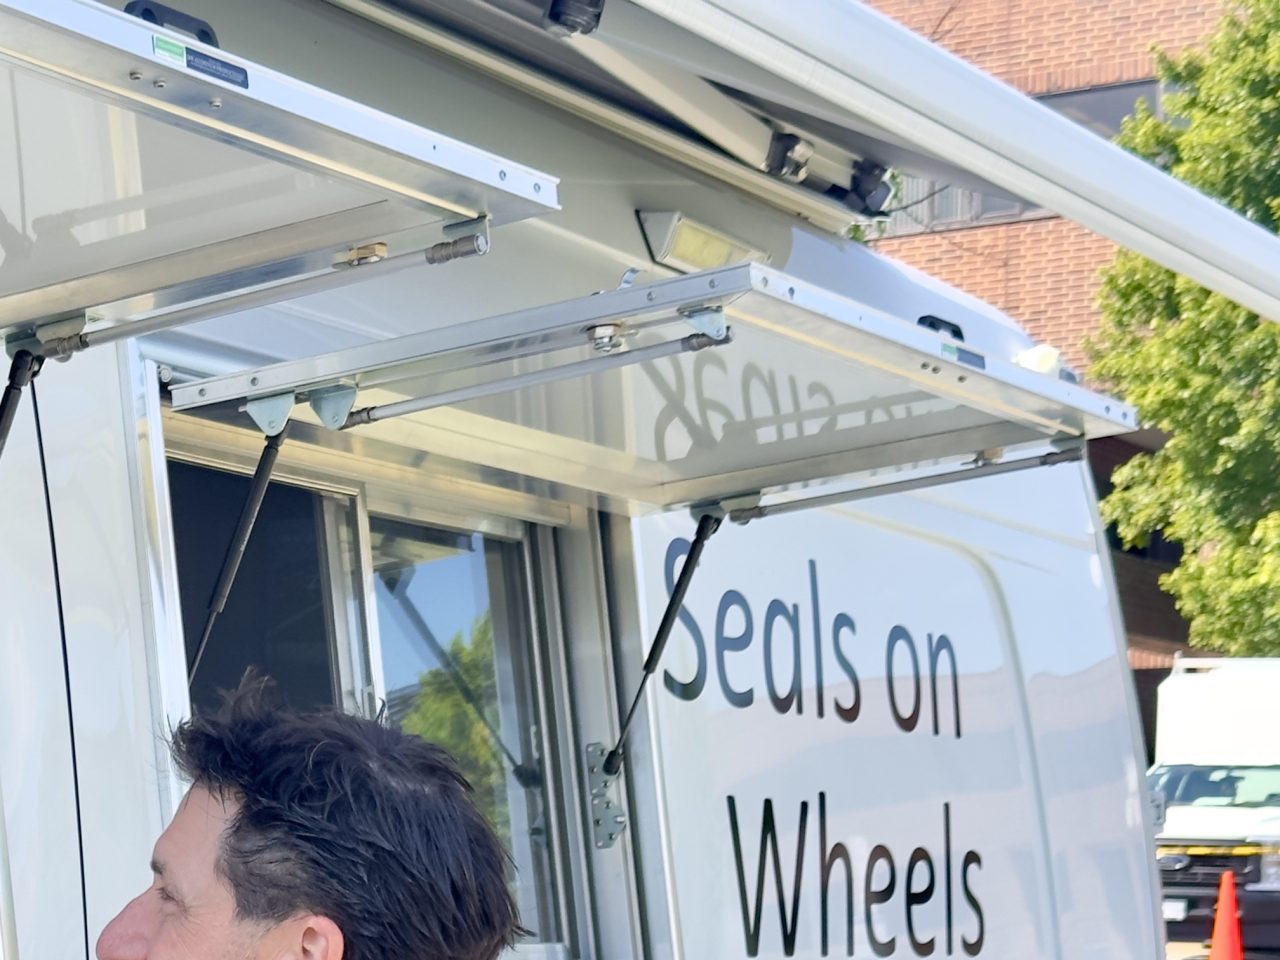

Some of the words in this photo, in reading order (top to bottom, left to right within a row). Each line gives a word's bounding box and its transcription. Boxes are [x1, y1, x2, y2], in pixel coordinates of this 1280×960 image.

[663, 536, 862, 723] Seals
[885, 624, 962, 739] on
[726, 790, 985, 958] Wheels
